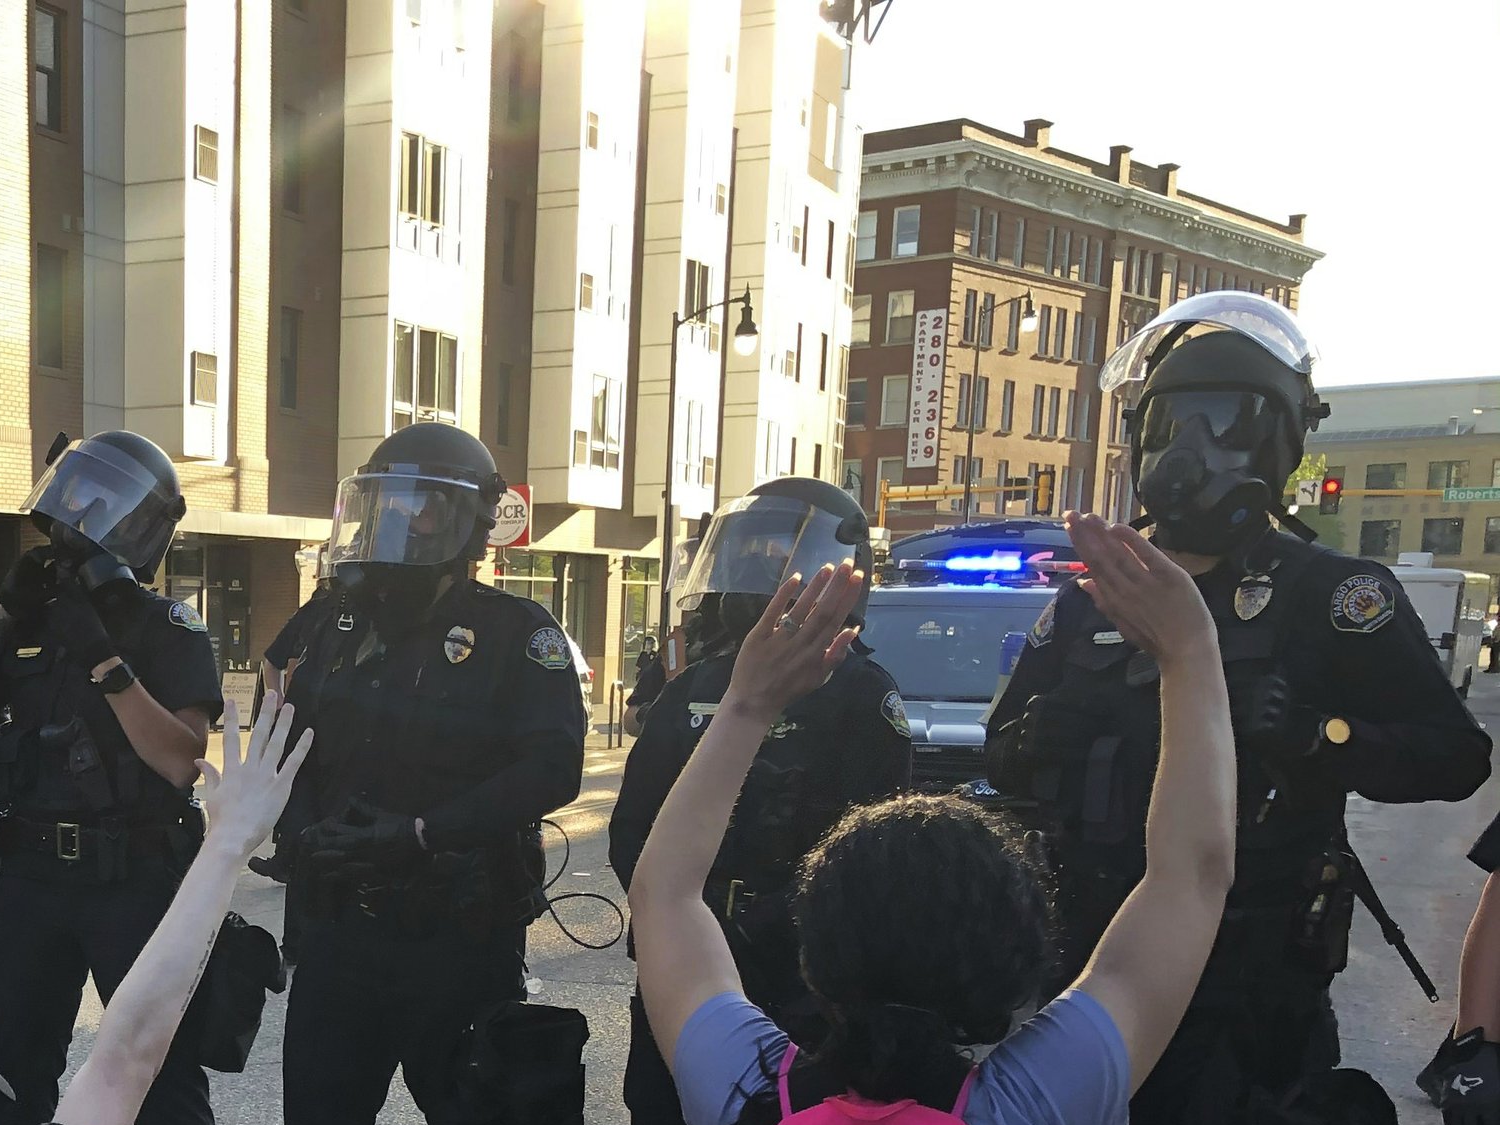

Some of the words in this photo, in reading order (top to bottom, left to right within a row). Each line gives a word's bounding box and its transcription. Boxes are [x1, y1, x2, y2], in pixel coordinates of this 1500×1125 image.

[914, 313, 928, 392] APARTMENTS
[912, 400, 921, 423] FOR
[910, 432, 919, 462] RENT
[1333, 585, 1349, 618] FARGO
[1346, 577, 1381, 590] POLICE
